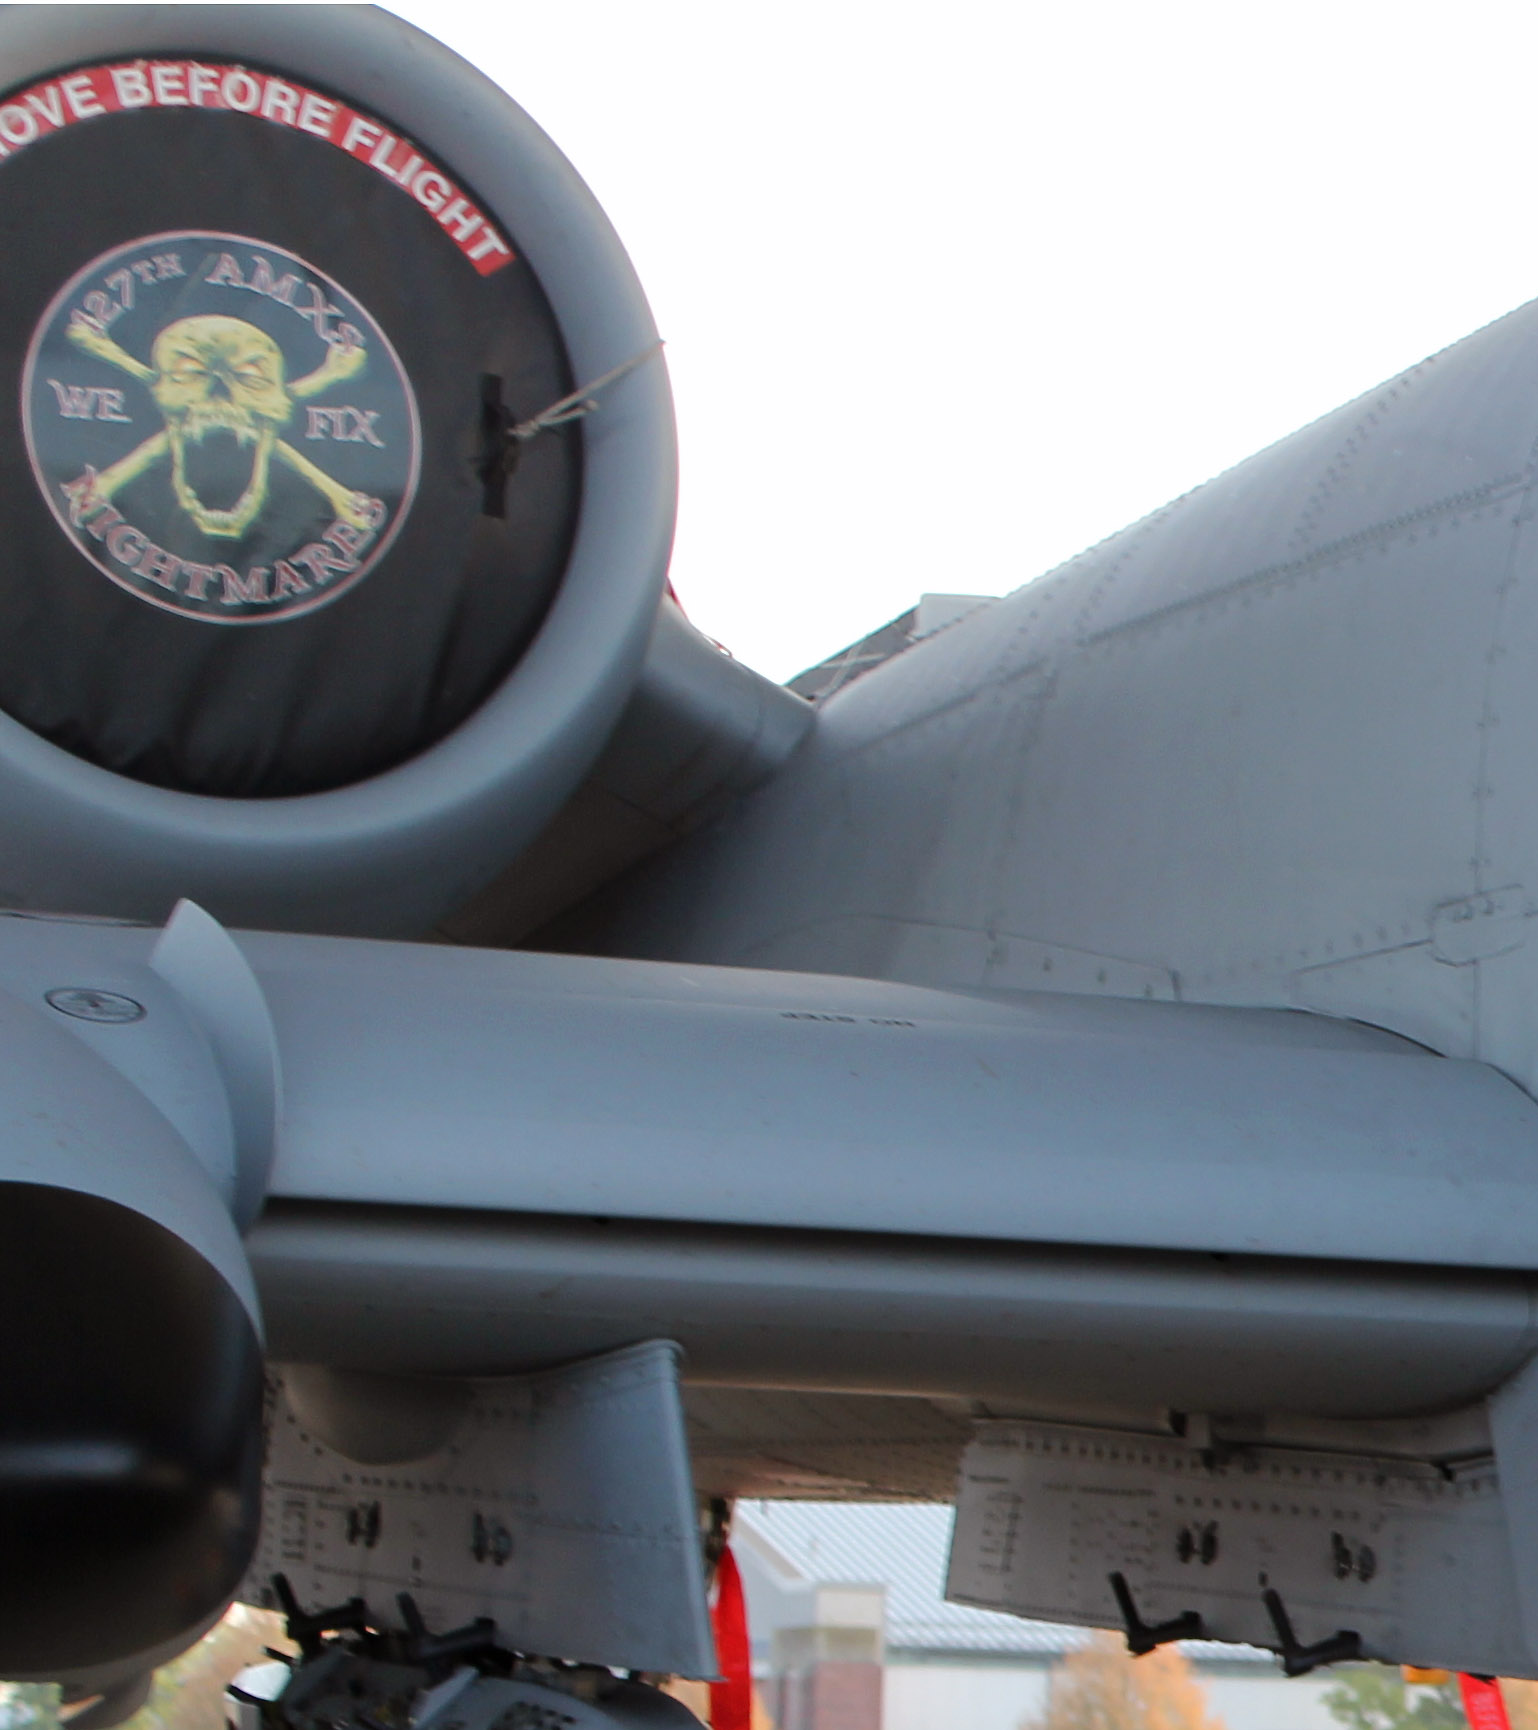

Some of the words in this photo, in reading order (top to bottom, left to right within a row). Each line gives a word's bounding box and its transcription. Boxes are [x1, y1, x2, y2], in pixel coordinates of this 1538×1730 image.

[0, 76, 107, 156] OVE
[110, 64, 338, 138] BEFORE
[341, 118, 508, 266] FLIGHT
[46, 379, 132, 424] WE
[305, 405, 385, 449] FIX
[60, 464, 388, 604] NIGHTMARES
